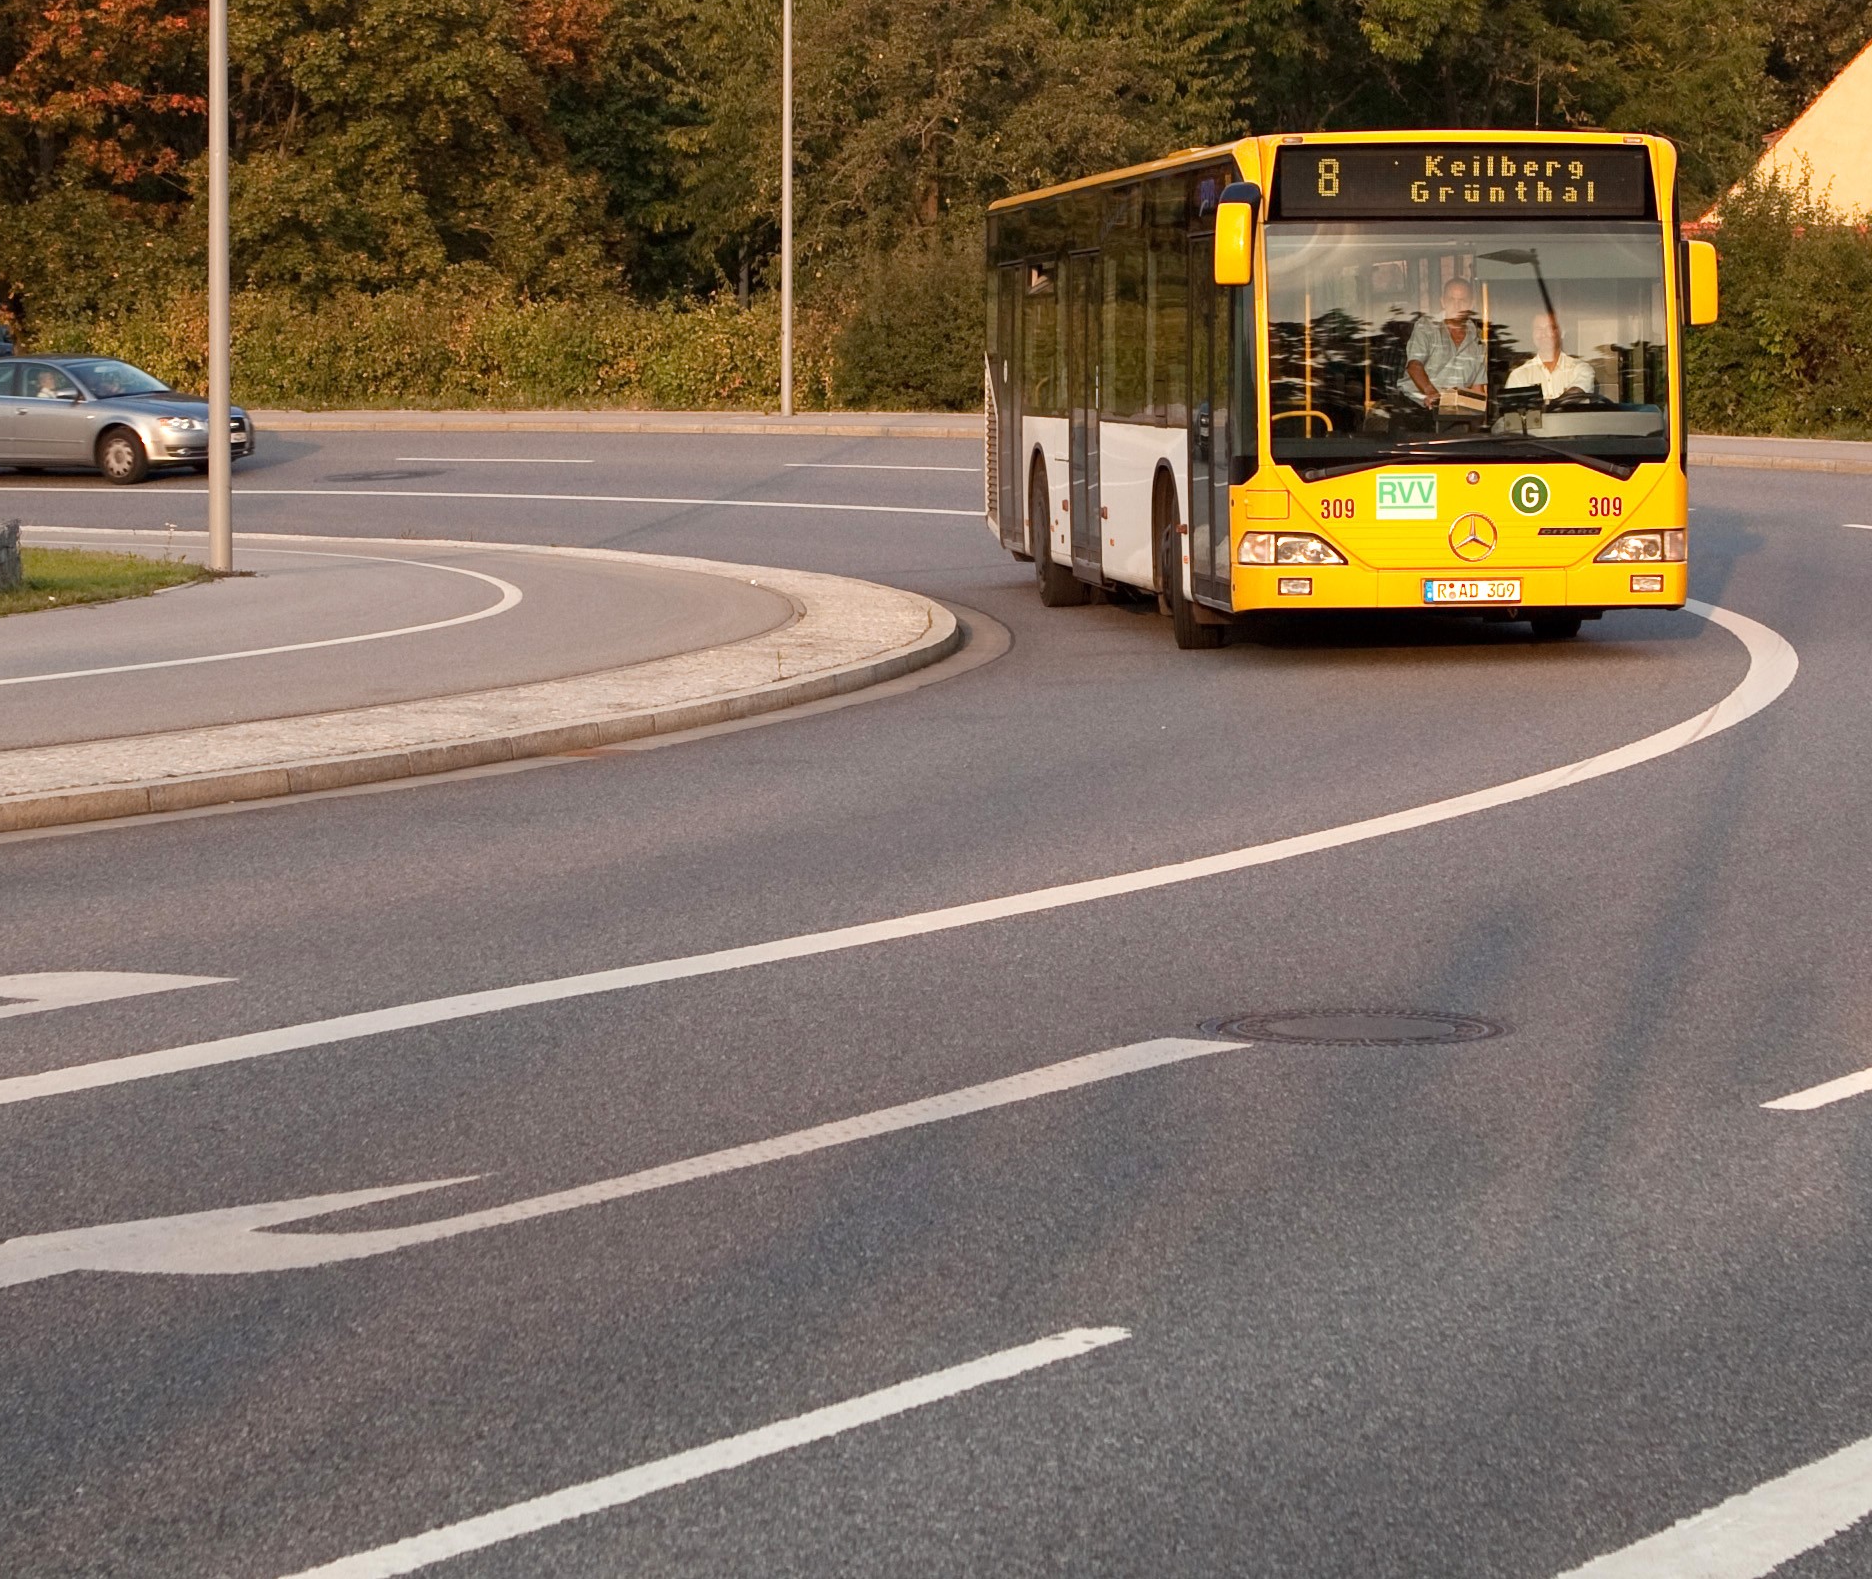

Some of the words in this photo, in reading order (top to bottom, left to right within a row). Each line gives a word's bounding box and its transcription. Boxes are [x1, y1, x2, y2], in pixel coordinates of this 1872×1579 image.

[1318, 158, 1340, 197] 8
[1425, 155, 1584, 180] Keilberg
[1410, 180, 1595, 203] Grünthal
[1378, 481, 1435, 504] RVV
[1520, 481, 1540, 508] G
[1320, 498, 1355, 519] 309
[1588, 496, 1623, 517] 309
[1540, 527, 1599, 535] CITARO
[1487, 583, 1515, 598] 309
